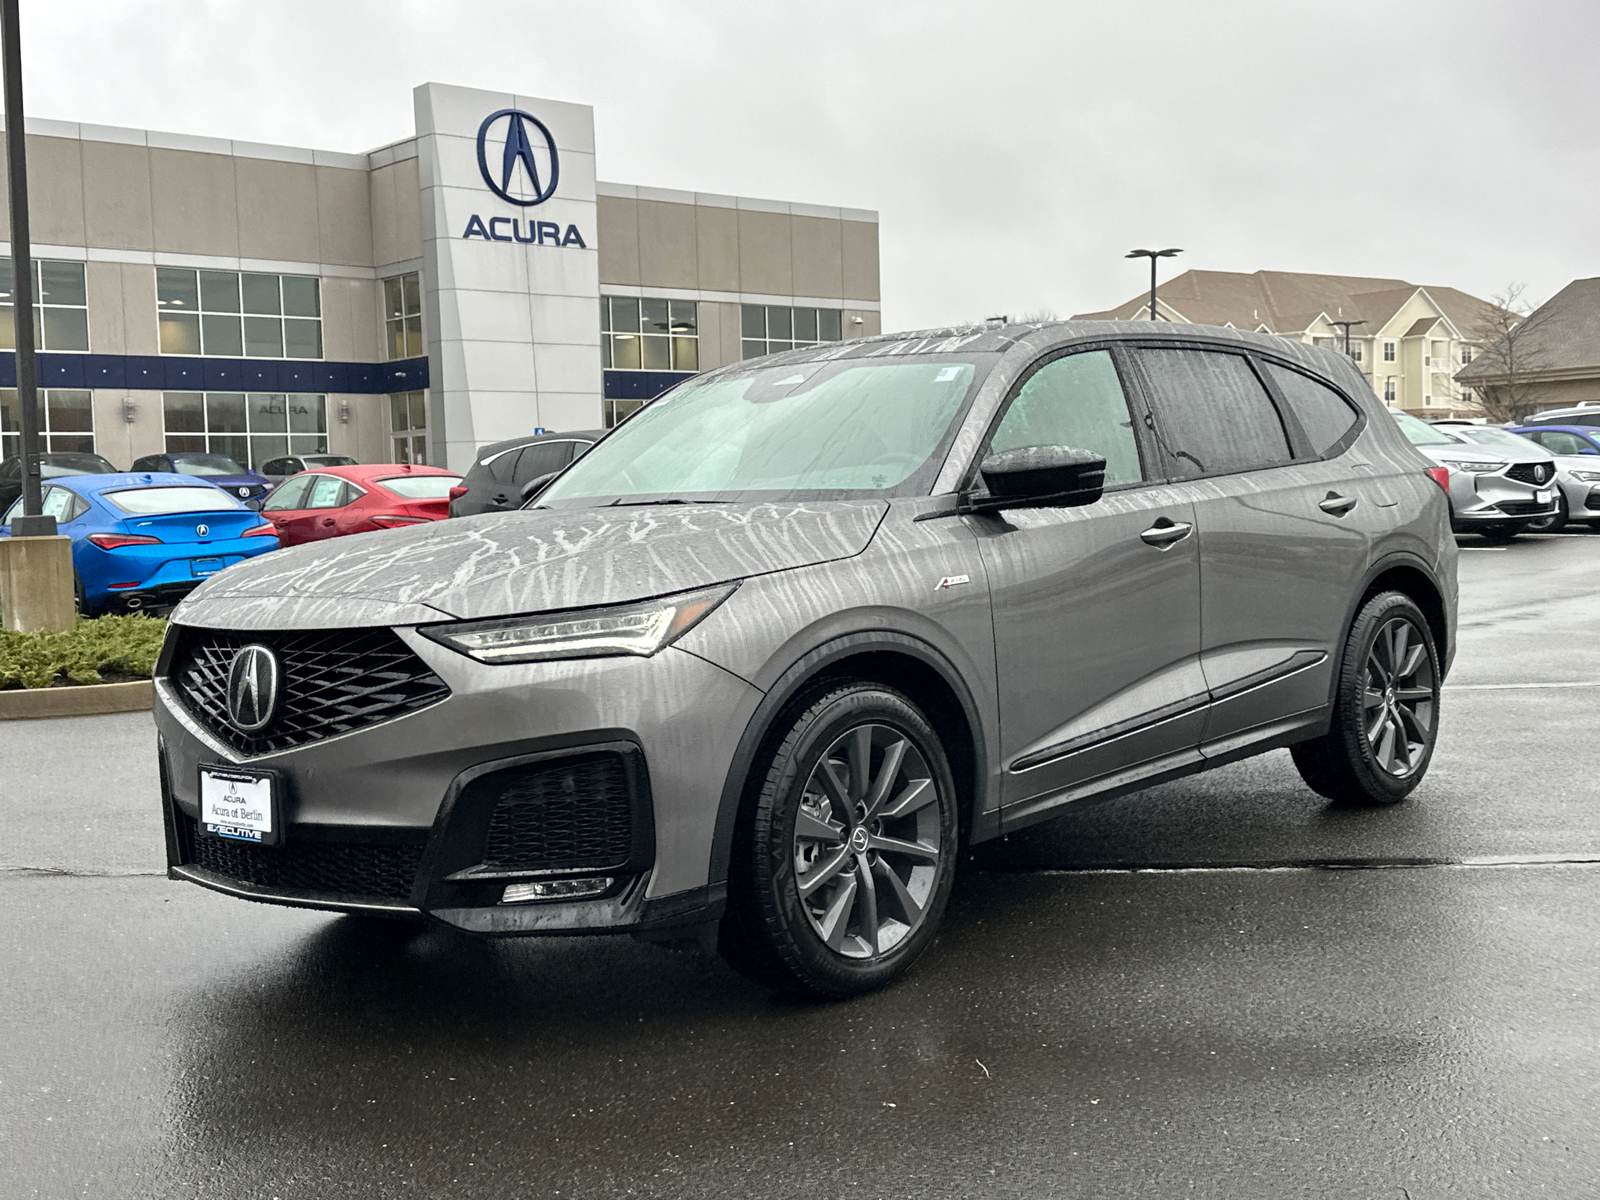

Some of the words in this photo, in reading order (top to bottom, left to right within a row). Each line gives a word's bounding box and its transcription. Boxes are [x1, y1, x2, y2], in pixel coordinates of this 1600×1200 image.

[462, 214, 587, 249] ACURA
[259, 405, 308, 415] ACURA
[223, 795, 247, 805] ACURA
[212, 804, 230, 817] Acura
[231, 808, 239, 819] of
[240, 808, 264, 822] Berlin
[207, 823, 262, 840] EXECUTIVE
